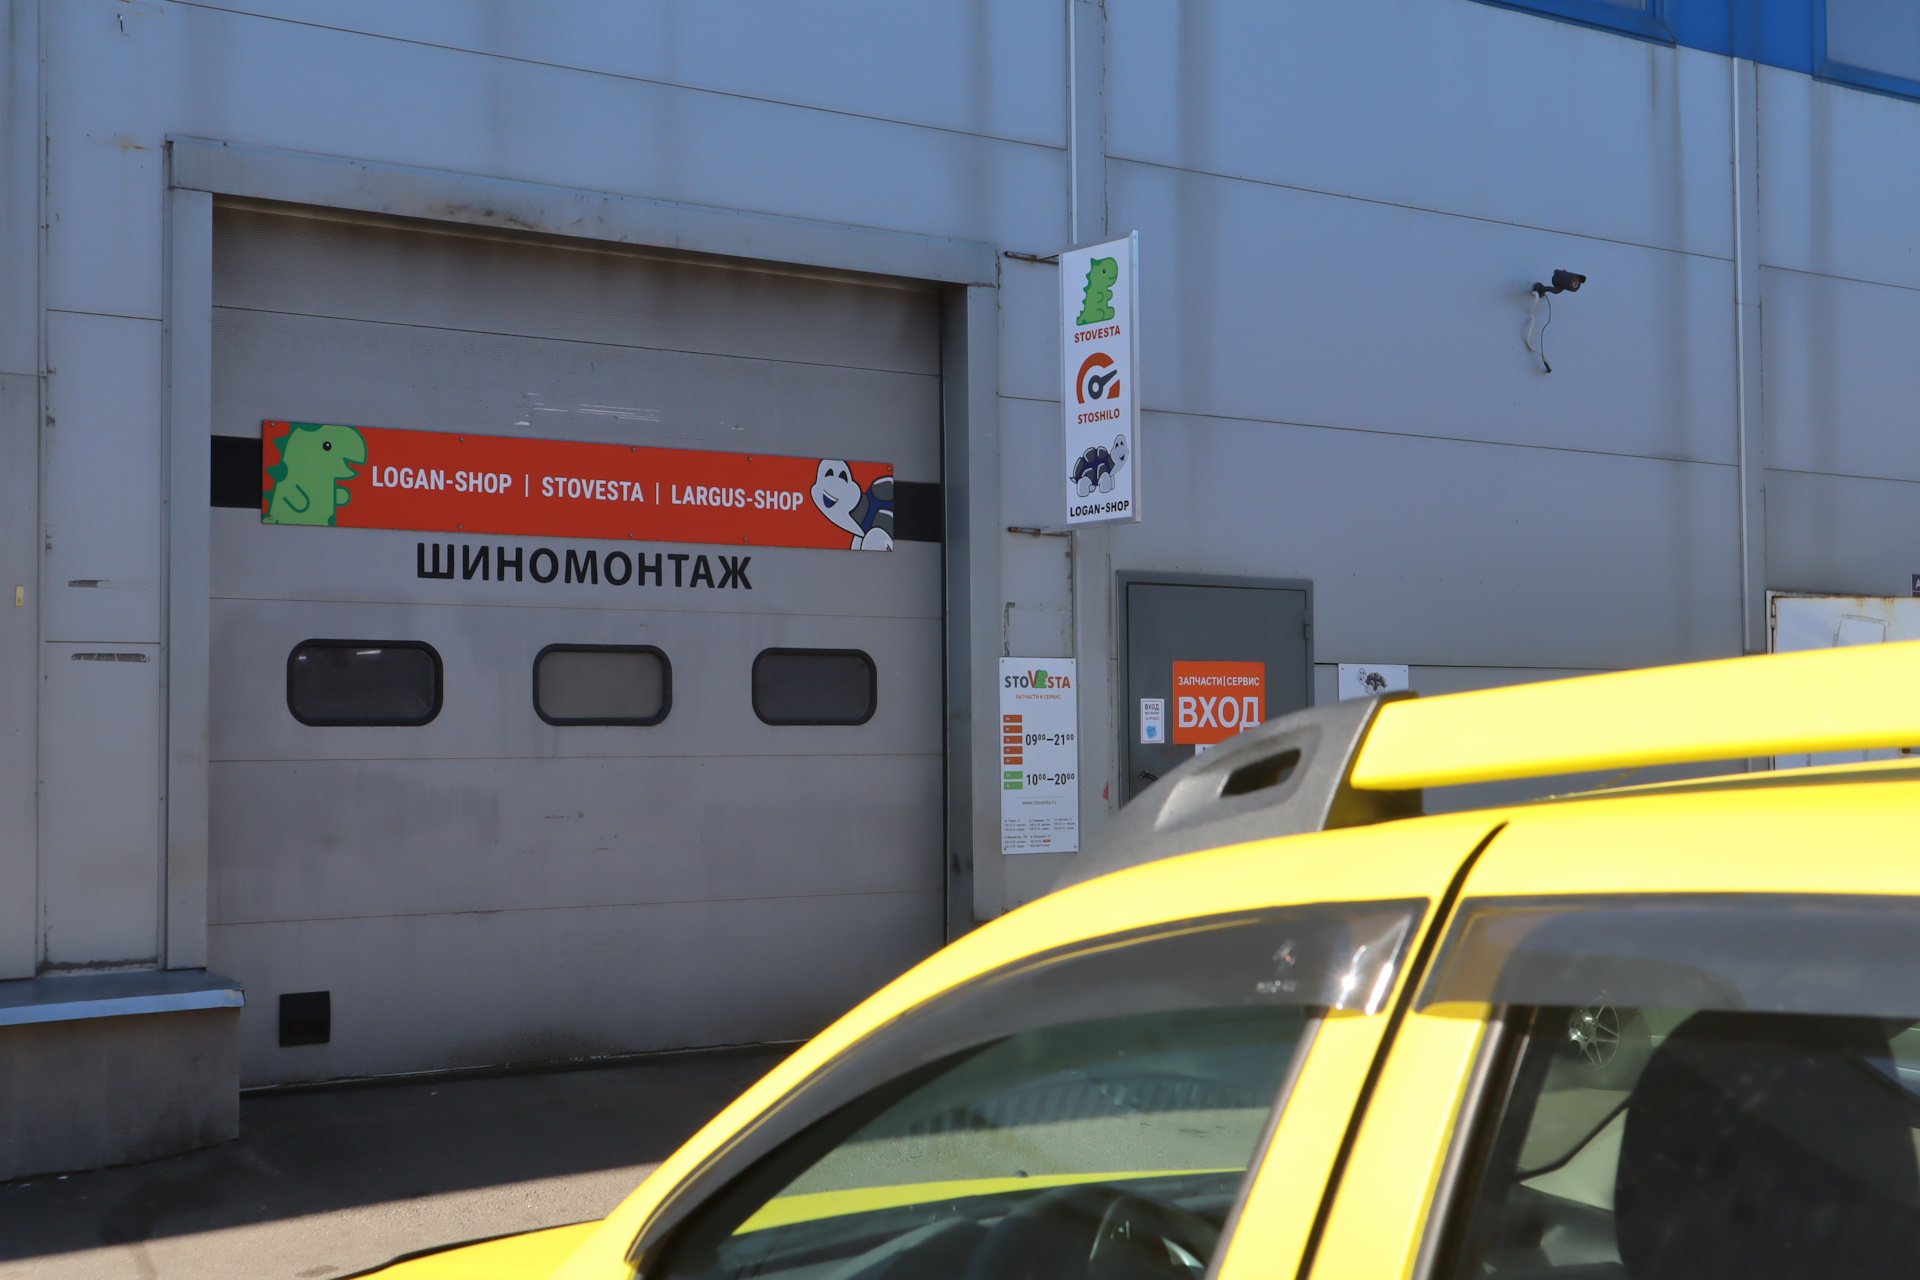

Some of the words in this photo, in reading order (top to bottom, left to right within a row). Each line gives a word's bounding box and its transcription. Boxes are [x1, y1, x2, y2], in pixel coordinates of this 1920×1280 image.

[1074, 325, 1121, 343] STOVESTA
[1077, 407, 1121, 425] STOSHILO
[371, 465, 513, 495] LOGAN-SHOP
[541, 476, 644, 503] STOVESTA
[671, 484, 804, 512] LARGUS-SHOP
[1069, 500, 1130, 517] LOGAN-SHOP
[416, 542, 753, 590] ШИНОМОНТАЖ
[1004, 669, 1071, 689] STOVSTA
[1178, 696, 1261, 734] ВХОД
